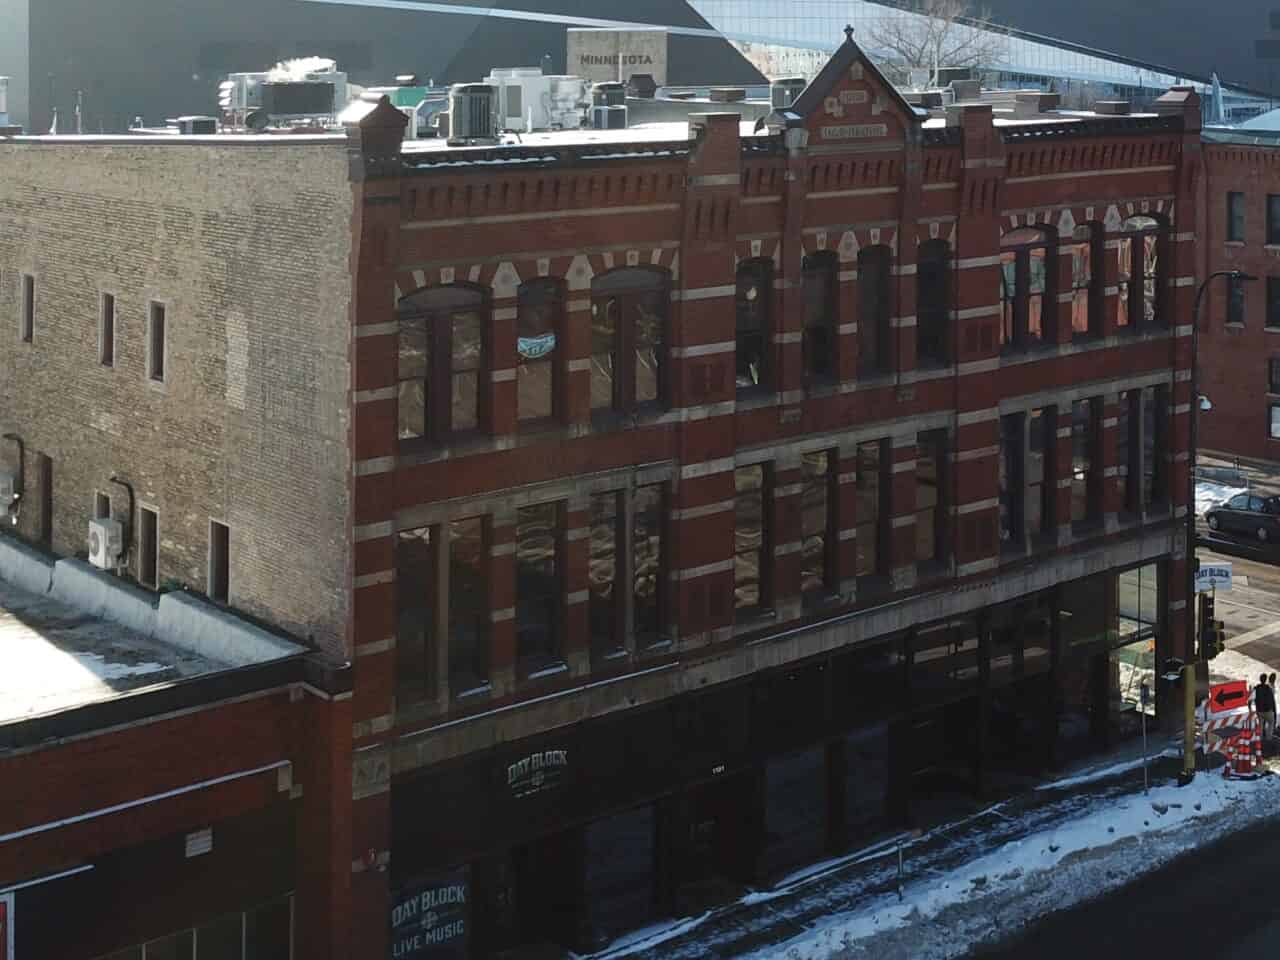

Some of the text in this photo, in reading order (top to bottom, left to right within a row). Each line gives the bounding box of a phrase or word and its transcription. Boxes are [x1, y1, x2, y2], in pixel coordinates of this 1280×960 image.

[580, 55, 653, 65] MINNESOTA
[507, 756, 530, 784] DAY
[392, 885, 465, 928] DAY BLOCK
[393, 919, 464, 957] LIVE MUSIC
